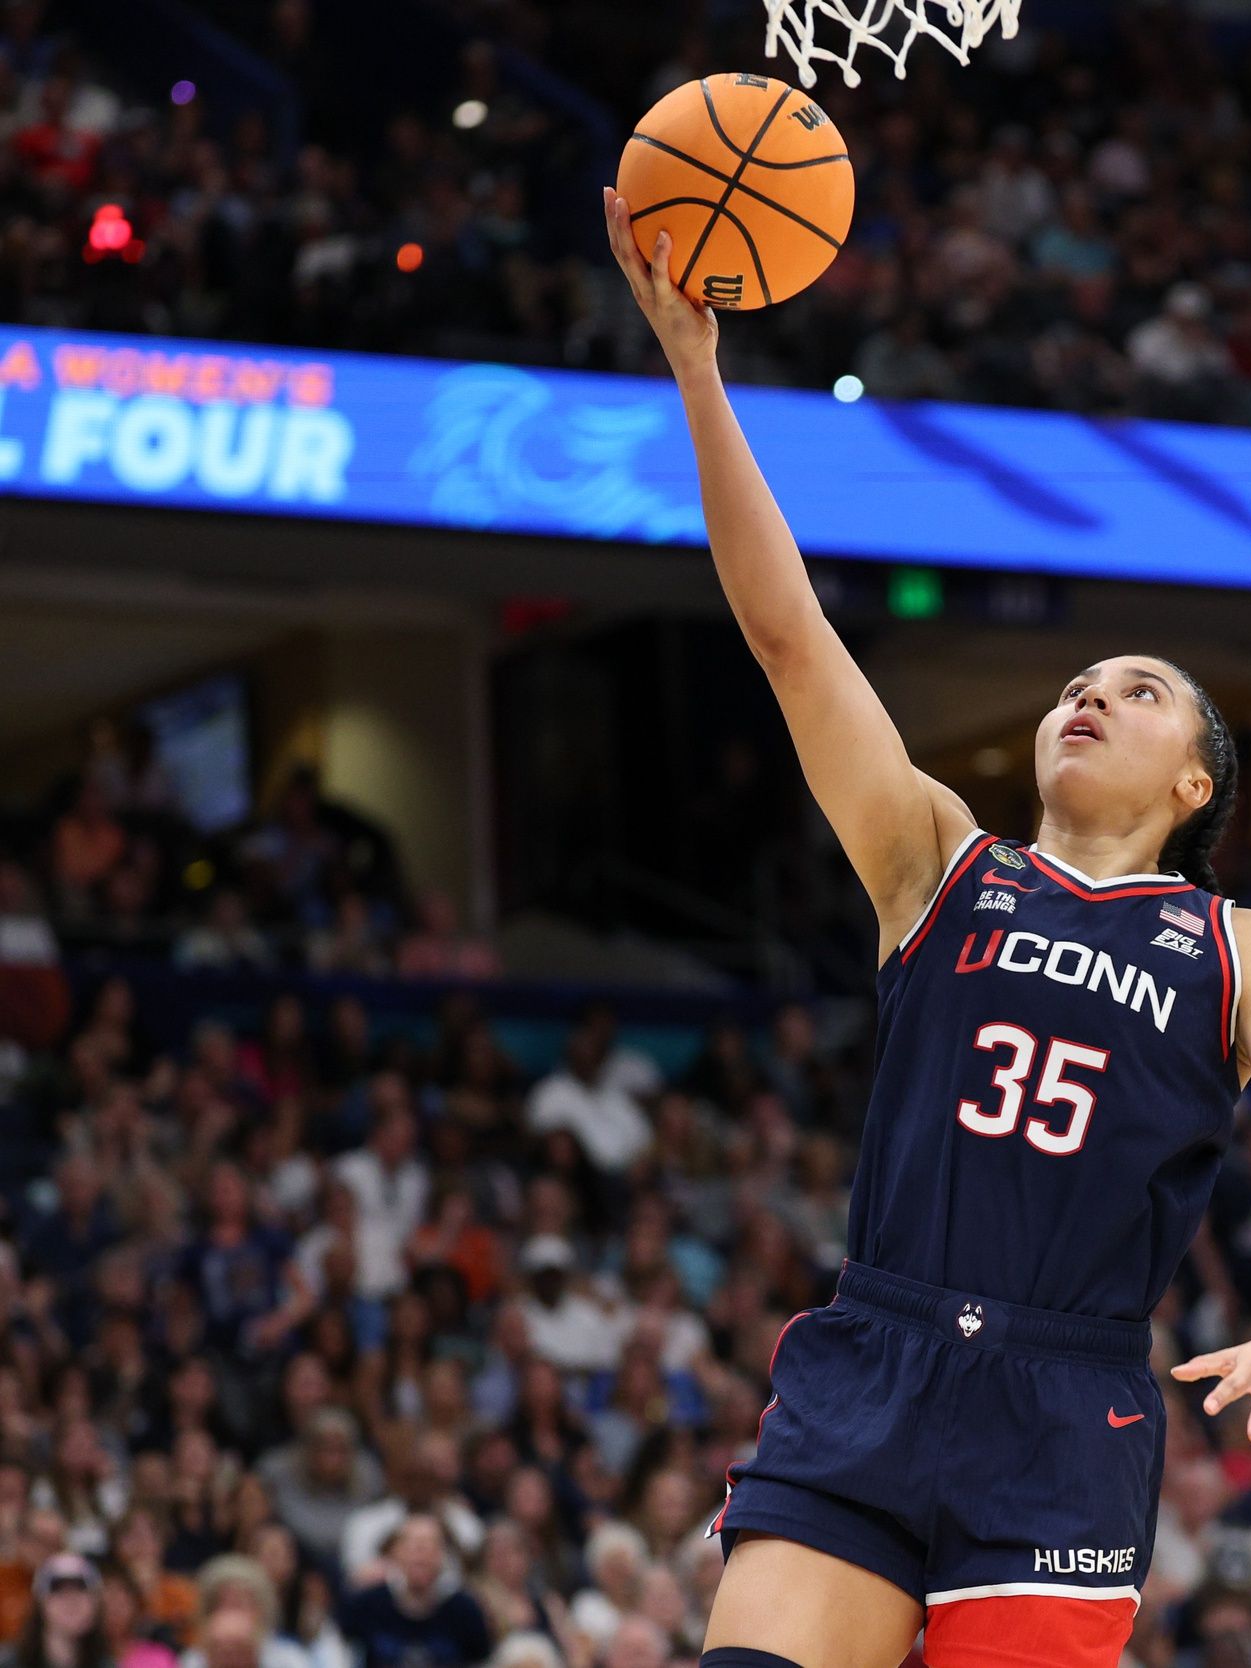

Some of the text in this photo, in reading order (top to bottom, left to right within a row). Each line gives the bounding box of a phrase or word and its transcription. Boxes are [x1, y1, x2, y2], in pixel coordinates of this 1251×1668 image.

[55, 343, 334, 411] WOMEN'S
[40, 388, 355, 505] FOUR
[973, 899, 1016, 914] CHANGE
[979, 890, 1017, 905] BE THE
[1154, 934, 1204, 956] EAST
[1161, 928, 1197, 946] BIG
[954, 929, 1177, 1033] UCONN
[957, 1021, 1111, 1156] 35
[1034, 1547, 1136, 1573] HUSKIES
